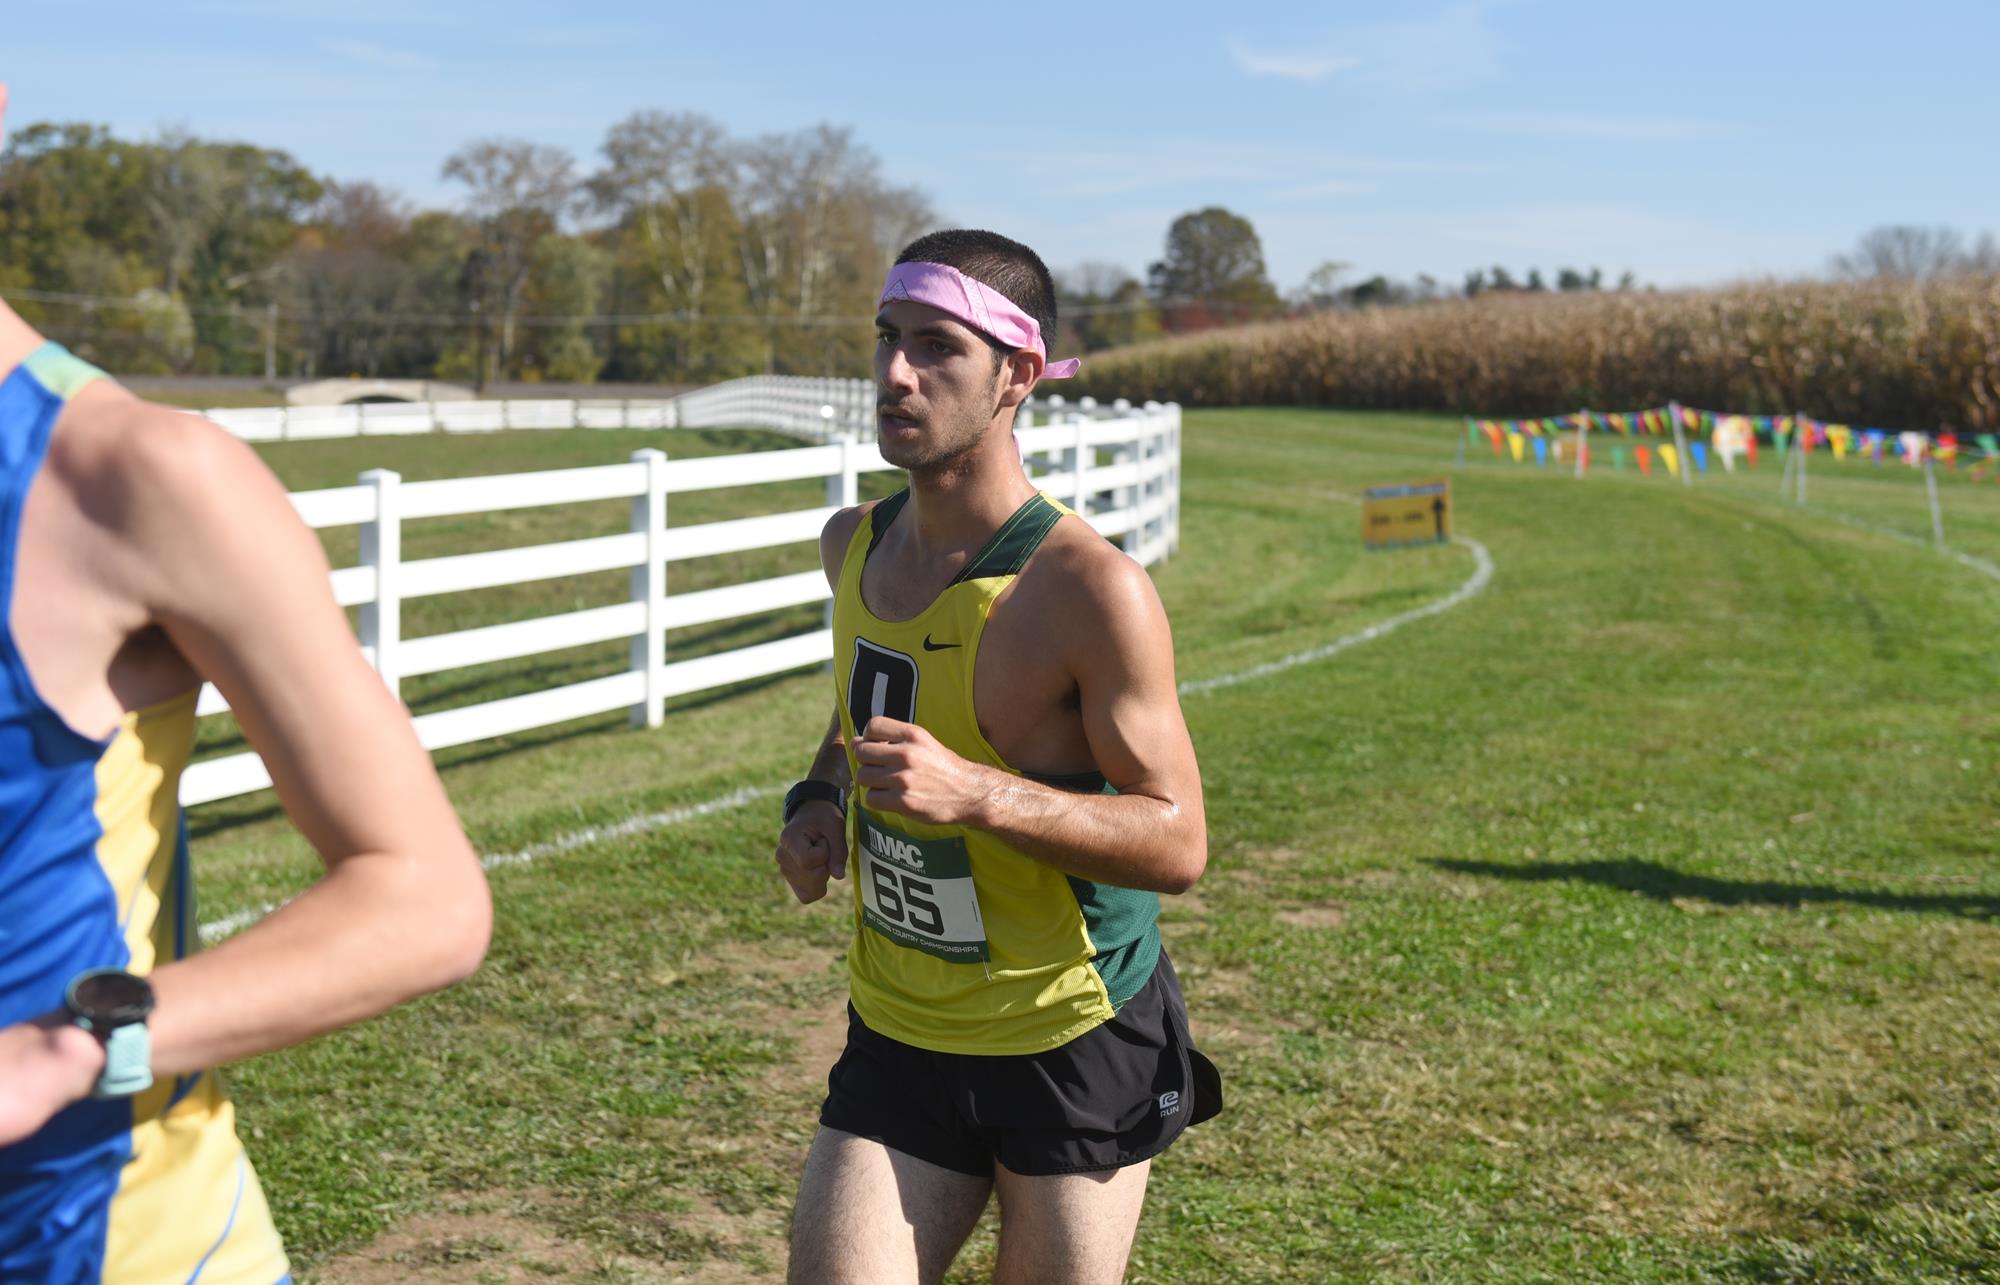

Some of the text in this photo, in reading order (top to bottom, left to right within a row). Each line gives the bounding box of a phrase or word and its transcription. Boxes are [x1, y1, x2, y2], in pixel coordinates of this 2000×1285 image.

[875, 830, 924, 869] MAC
[871, 861, 945, 937] 65
[1160, 1105, 1180, 1118] RUN
